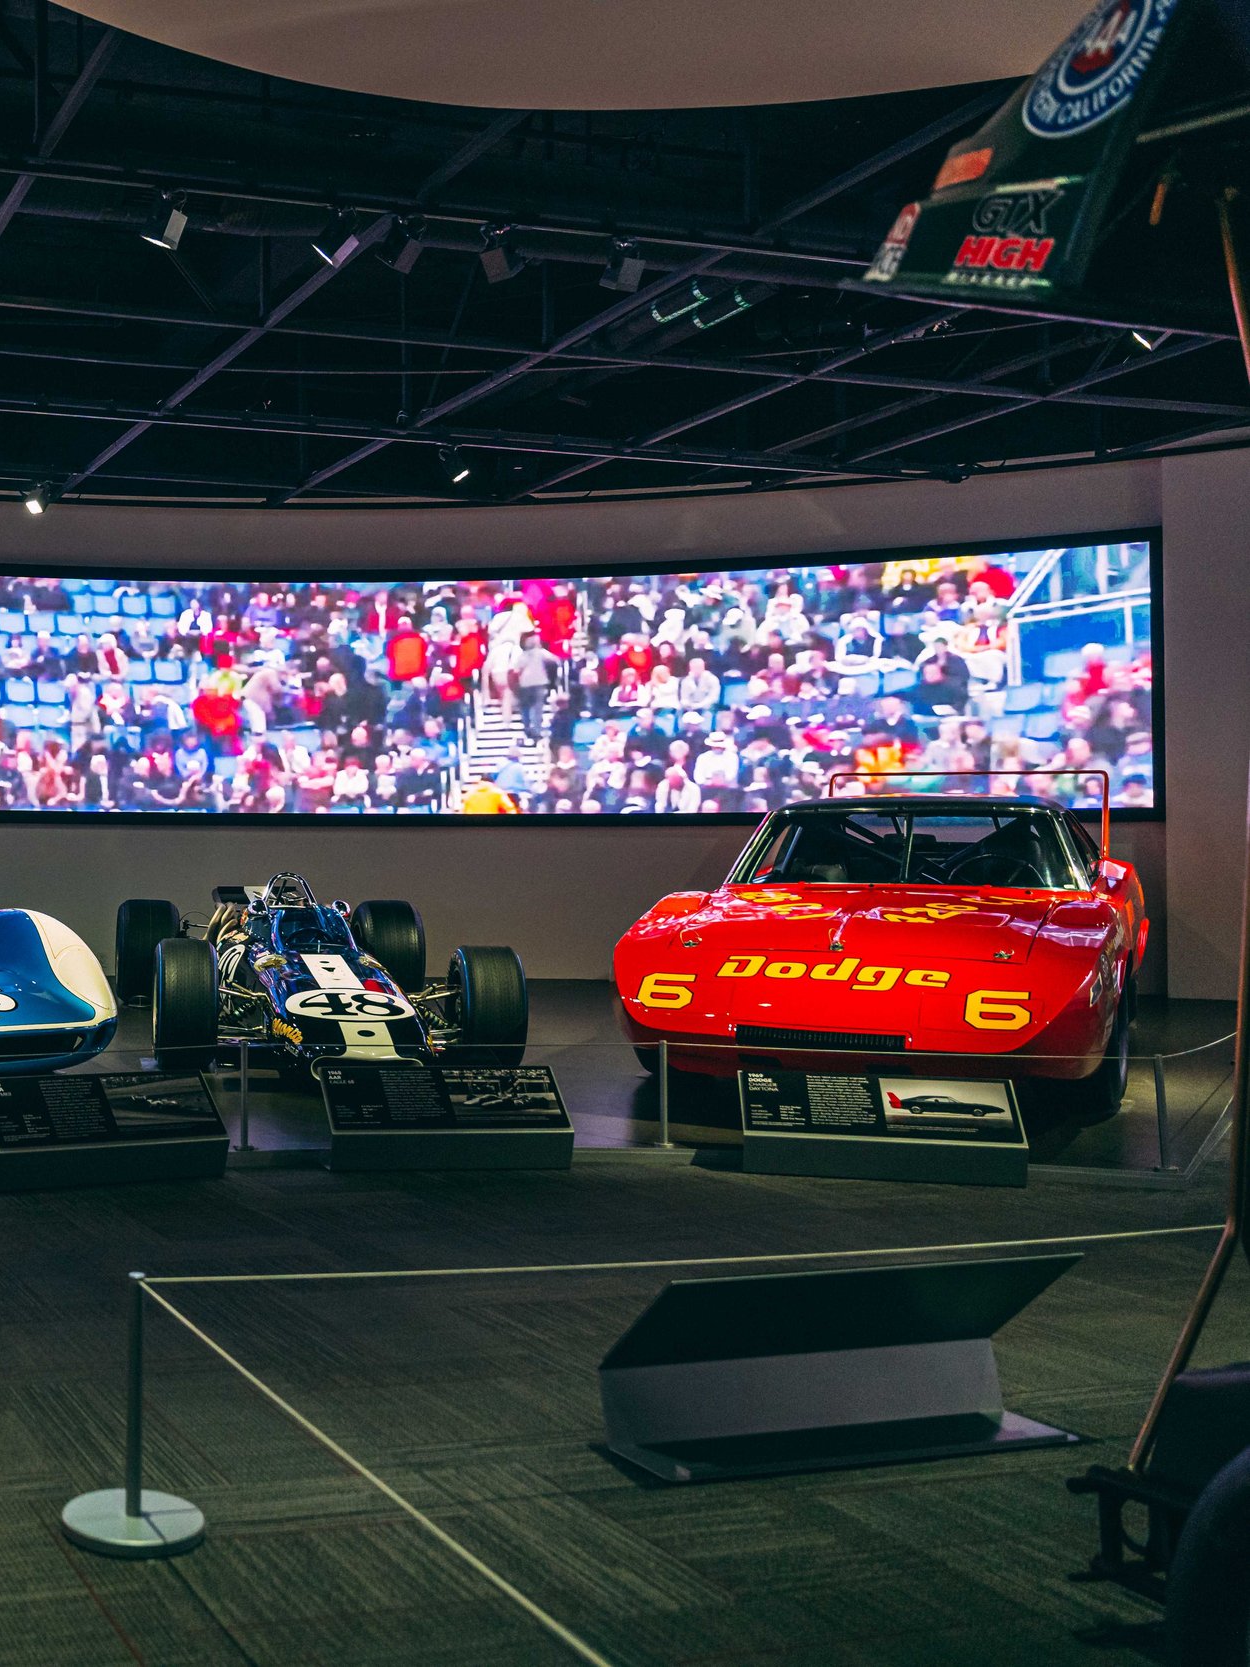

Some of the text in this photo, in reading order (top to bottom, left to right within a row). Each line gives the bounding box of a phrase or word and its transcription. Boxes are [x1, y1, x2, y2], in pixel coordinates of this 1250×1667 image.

[1056, 26, 1164, 125] CALIFORNIA
[972, 188, 1065, 235] GTX
[953, 235, 1055, 272] HIGH
[883, 902, 979, 924] 426
[636, 972, 697, 1010] 6
[716, 955, 951, 992] Dodge
[299, 992, 406, 1017] 48
[963, 990, 1032, 1031] 6
